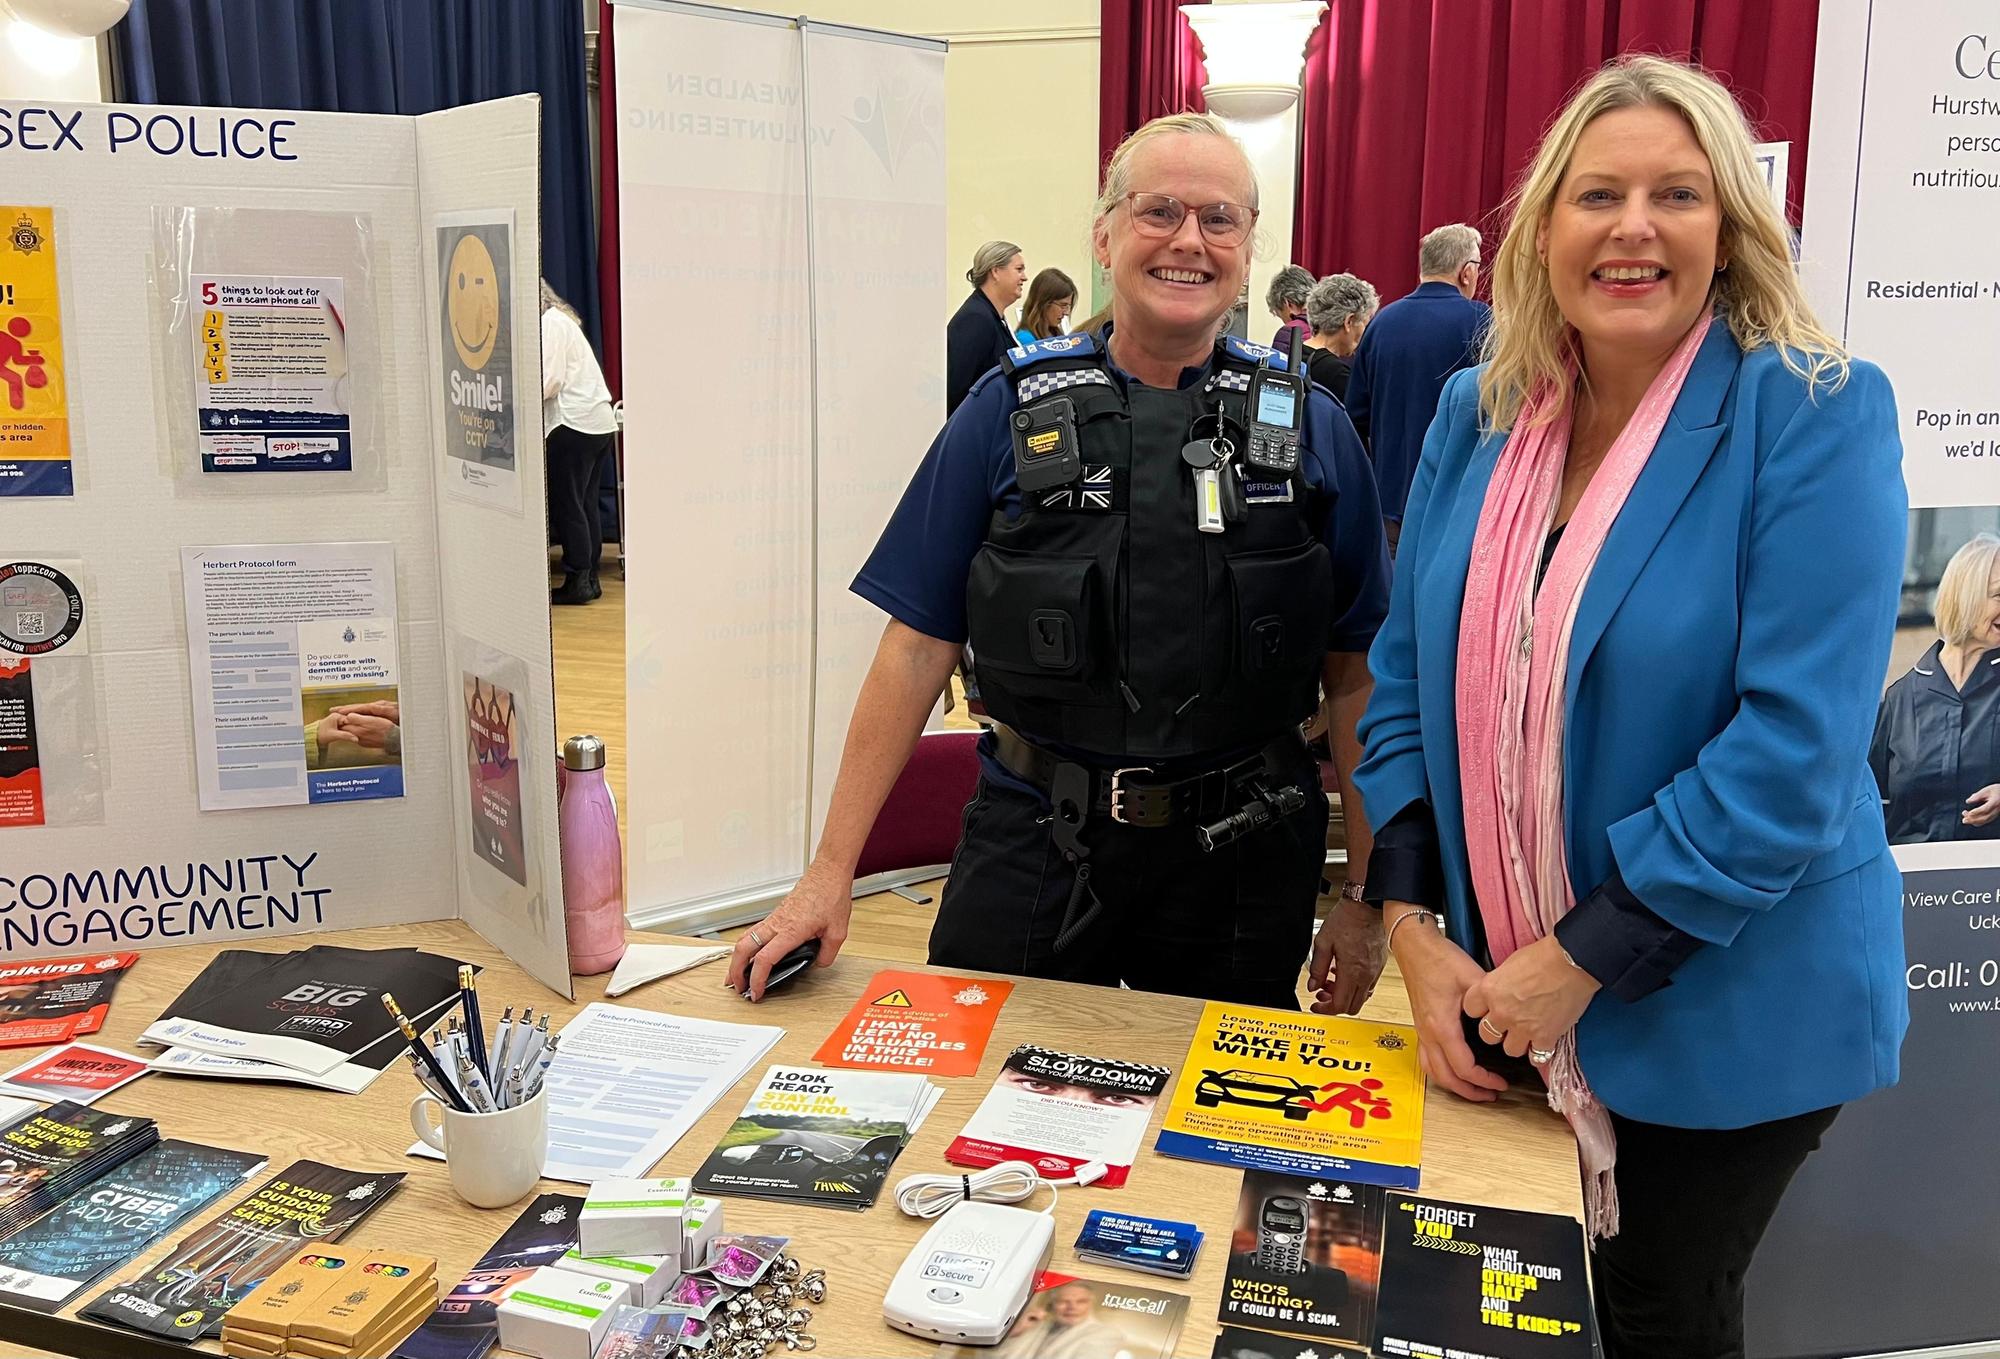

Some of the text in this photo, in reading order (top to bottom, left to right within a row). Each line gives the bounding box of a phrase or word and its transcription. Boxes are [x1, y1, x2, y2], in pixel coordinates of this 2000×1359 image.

[108, 112, 297, 160] POLICE
[1912, 168, 2000, 188] nutritiou
[202, 283, 320, 305] 5 things to look out for
[1867, 281, 1978, 298] Residential
[302, 297, 316, 305] call
[208, 330, 216, 338] 2
[212, 344, 220, 352] 3
[450, 369, 503, 413] Smile!
[484, 417, 495, 430] on
[1916, 409, 1951, 431] Pop
[1955, 409, 1971, 426] in
[272, 442, 300, 452] STOP!
[466, 430, 488, 448] CCTV
[1246, 483, 1280, 492] OFFICER
[0, 564, 57, 580] topTopps.com
[203, 560, 237, 569] Herbert
[239, 560, 274, 568] Protocol
[308, 666, 346, 674] dementia
[308, 674, 323, 682] they
[340, 672, 351, 680] go
[352, 670, 389, 678] missing?
[0, 852, 318, 913] COMMUNITY
[1909, 890, 1992, 908] View Care
[0, 888, 332, 951] NGAGEMENT
[1906, 962, 1970, 990] Call:
[281, 984, 370, 1007] BIG
[265, 1000, 344, 1018] SCAMS
[289, 1016, 345, 1029] THIRD
[596, 1012, 628, 1022] Herbert
[628, 1016, 661, 1028] Protocol
[868, 1021, 922, 1031] HAVE
[1222, 1014, 1326, 1036] Leave nothing
[279, 1024, 338, 1035] EDITION
[853, 1028, 936, 1040] LEFT NO
[1219, 1022, 1235, 1030] of
[1239, 1024, 1278, 1036] value
[1297, 1034, 1326, 1044] your
[1330, 1038, 1350, 1046] car
[190, 1032, 247, 1048] Sussex Police
[851, 1036, 966, 1051] VALUABLES
[1216, 1030, 1326, 1054] TAKE IT
[844, 1044, 920, 1056] IN THIS
[1212, 1040, 1372, 1072] WITH YOU!
[55, 1059, 101, 1070] UNDER
[841, 1052, 935, 1067] VEHICLE!
[774, 1072, 828, 1084] LOOK
[1022, 1064, 1152, 1092] MAKE YOUR COMMUNITY SAFER
[1028, 1054, 1157, 1086] SLOW DOWN
[768, 1082, 834, 1094] REACT
[761, 1092, 837, 1105] STAY IN
[756, 1100, 850, 1116] CONTROL
[20, 1124, 90, 1148] YOUR DOG
[31, 1116, 94, 1139] KEEPING
[1184, 1117, 1224, 1128] Thieves
[1248, 1127, 1300, 1141] operating
[1304, 1134, 1315, 1142] in
[1318, 1136, 1339, 1146] this
[1342, 1142, 1368, 1150] area
[4, 1132, 44, 1149] SAFE
[270, 1180, 332, 1202] IS YOUR
[814, 1180, 860, 1194] THINK!
[89, 1190, 180, 1217] CYBER
[244, 1198, 327, 1224] PROPERTY
[258, 1190, 332, 1214] OUTDOOR
[68, 1204, 164, 1232] ADVICE
[232, 1208, 282, 1227] SAFE?
[1414, 1219, 1453, 1240] YOU
[1482, 1246, 1518, 1262] WHAT
[939, 1268, 974, 1282] Secure
[1482, 1258, 1562, 1281] ABOUT YOUR
[1232, 1278, 1288, 1296] WHO'S
[1481, 1270, 1538, 1291] OTHER
[1230, 1290, 1314, 1310] CALLING?
[1481, 1282, 1524, 1303] HALF
[1104, 1293, 1167, 1315] trueCall
[1480, 1296, 1509, 1313] AND
[1228, 1301, 1341, 1327] IT COULD BE A SCAM.
[1480, 1308, 1514, 1328] THE
